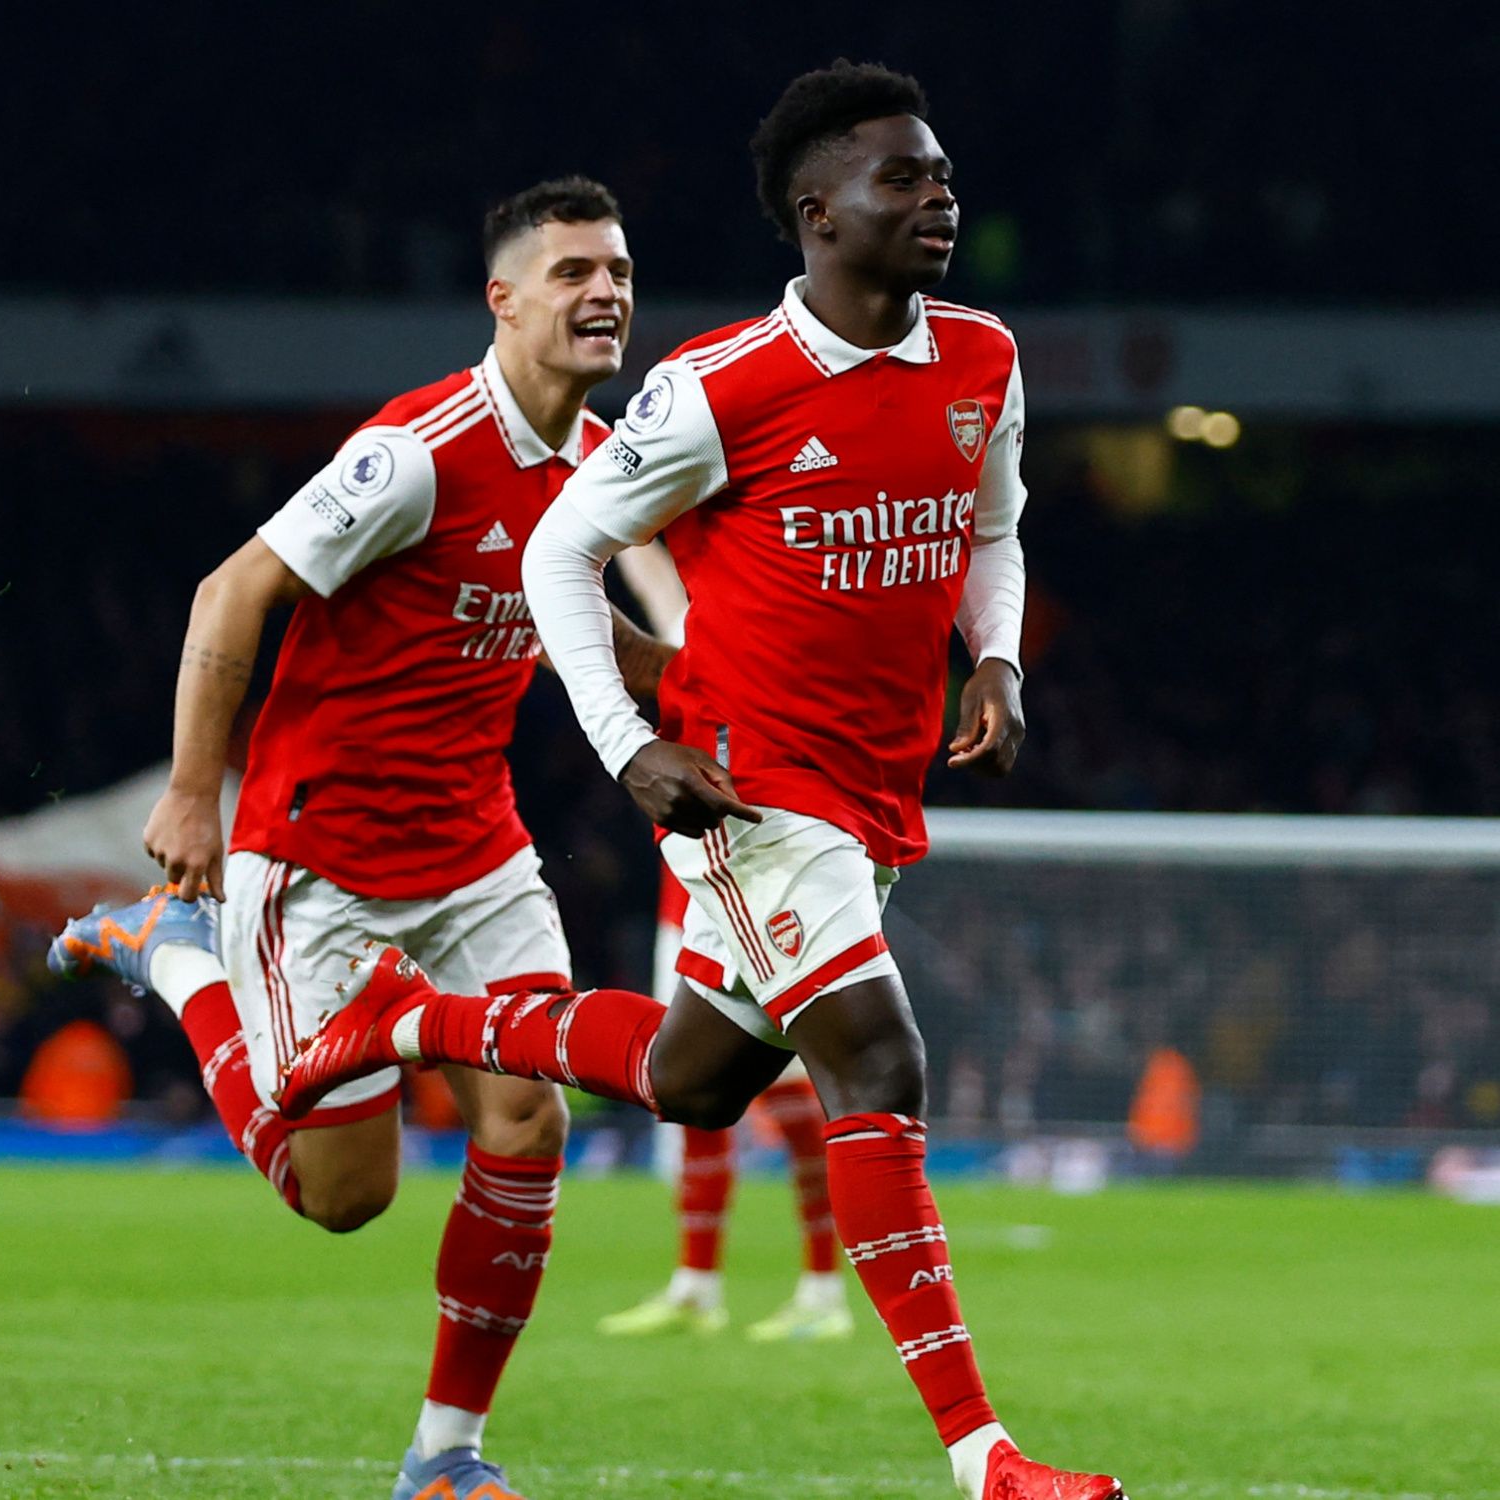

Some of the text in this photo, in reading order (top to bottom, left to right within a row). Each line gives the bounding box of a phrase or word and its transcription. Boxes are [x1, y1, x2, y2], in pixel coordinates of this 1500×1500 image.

[790, 455, 838, 473] adidas
[820, 536, 961, 591] FLY BETTER
[492, 1251, 550, 1271] AF
